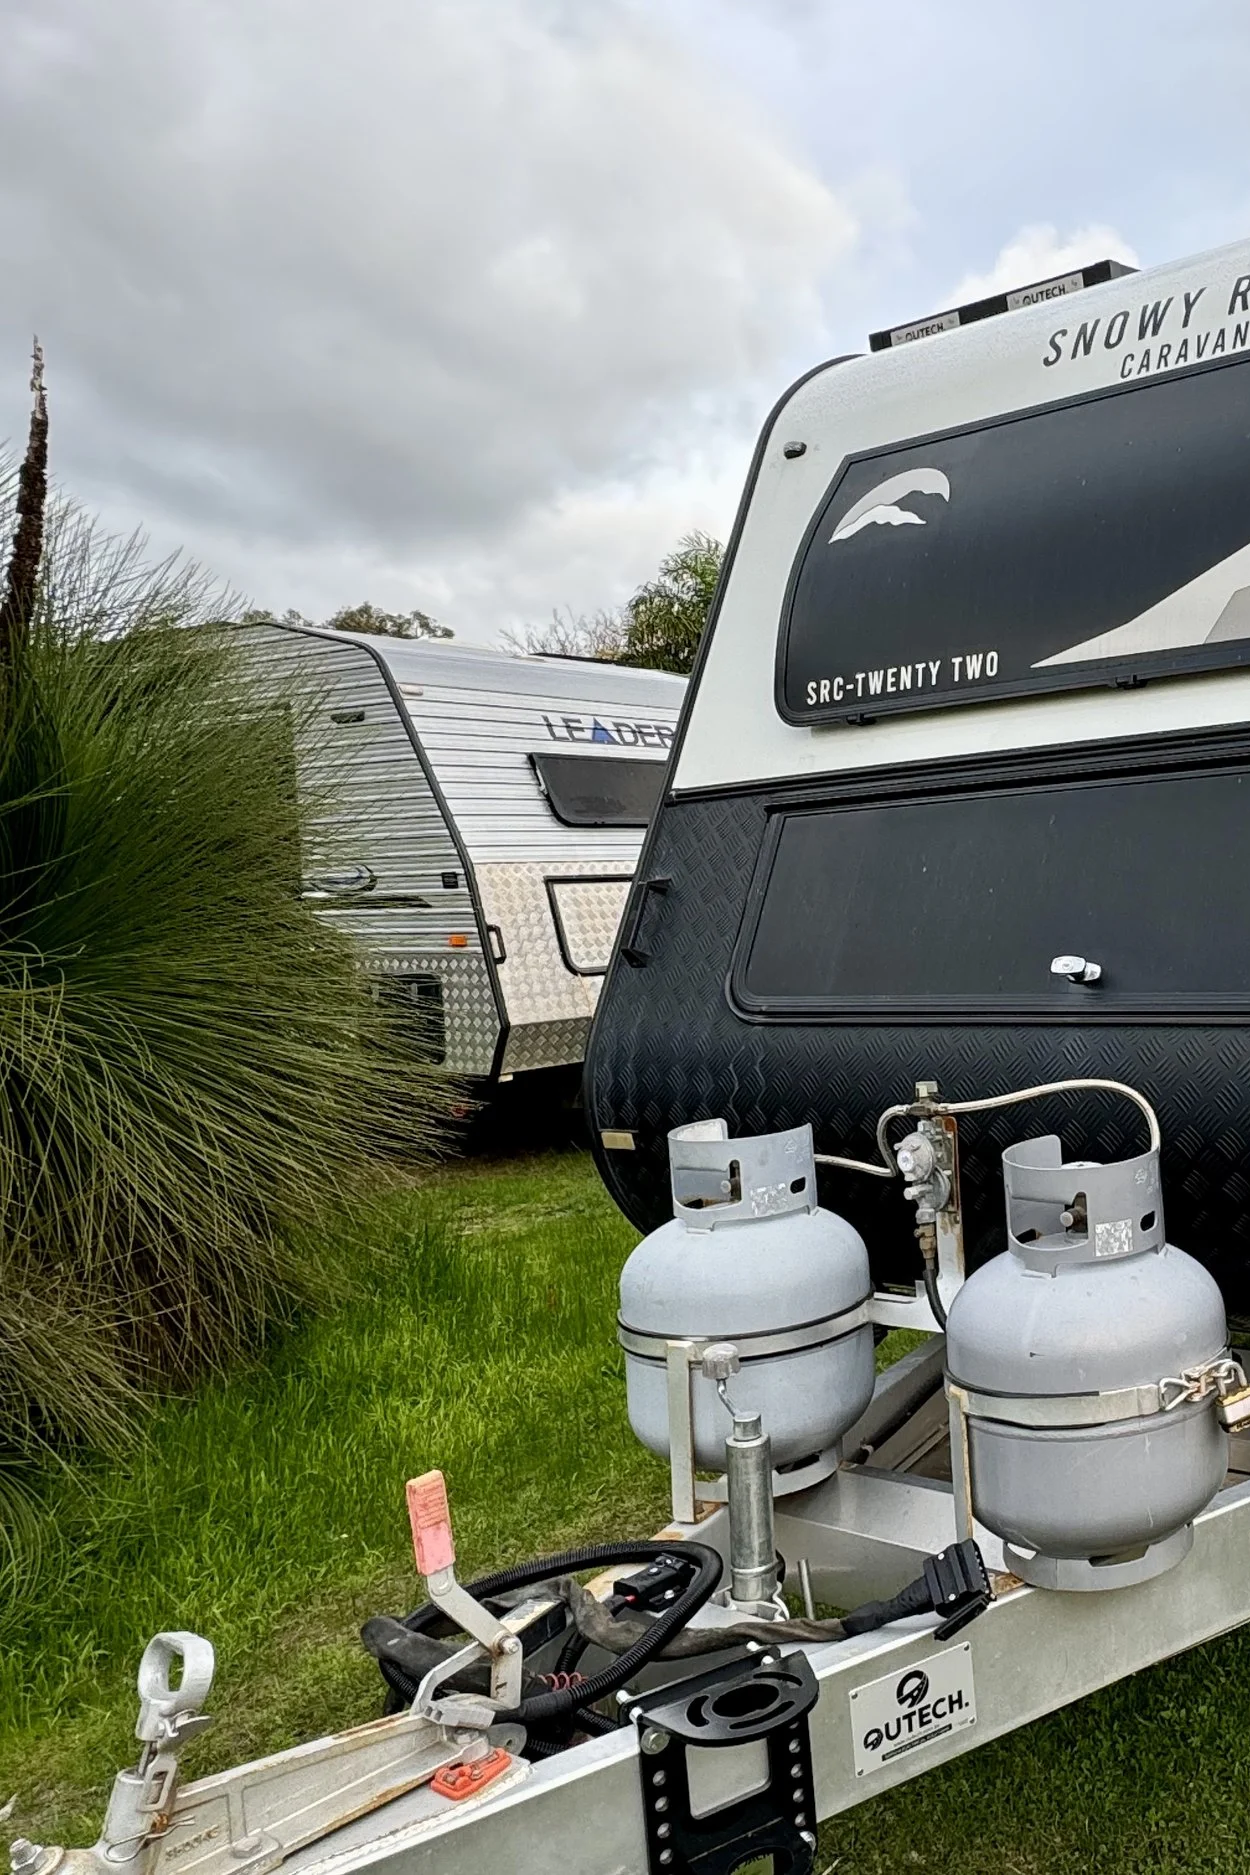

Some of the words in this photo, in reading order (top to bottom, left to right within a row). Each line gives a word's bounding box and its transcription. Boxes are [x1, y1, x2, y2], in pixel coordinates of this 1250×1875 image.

[1043, 286, 1208, 368] SNOWY
[806, 659, 942, 706] SRC-TWENTY
[951, 650, 999, 682] TWO
[541, 714, 676, 749] LEADER
